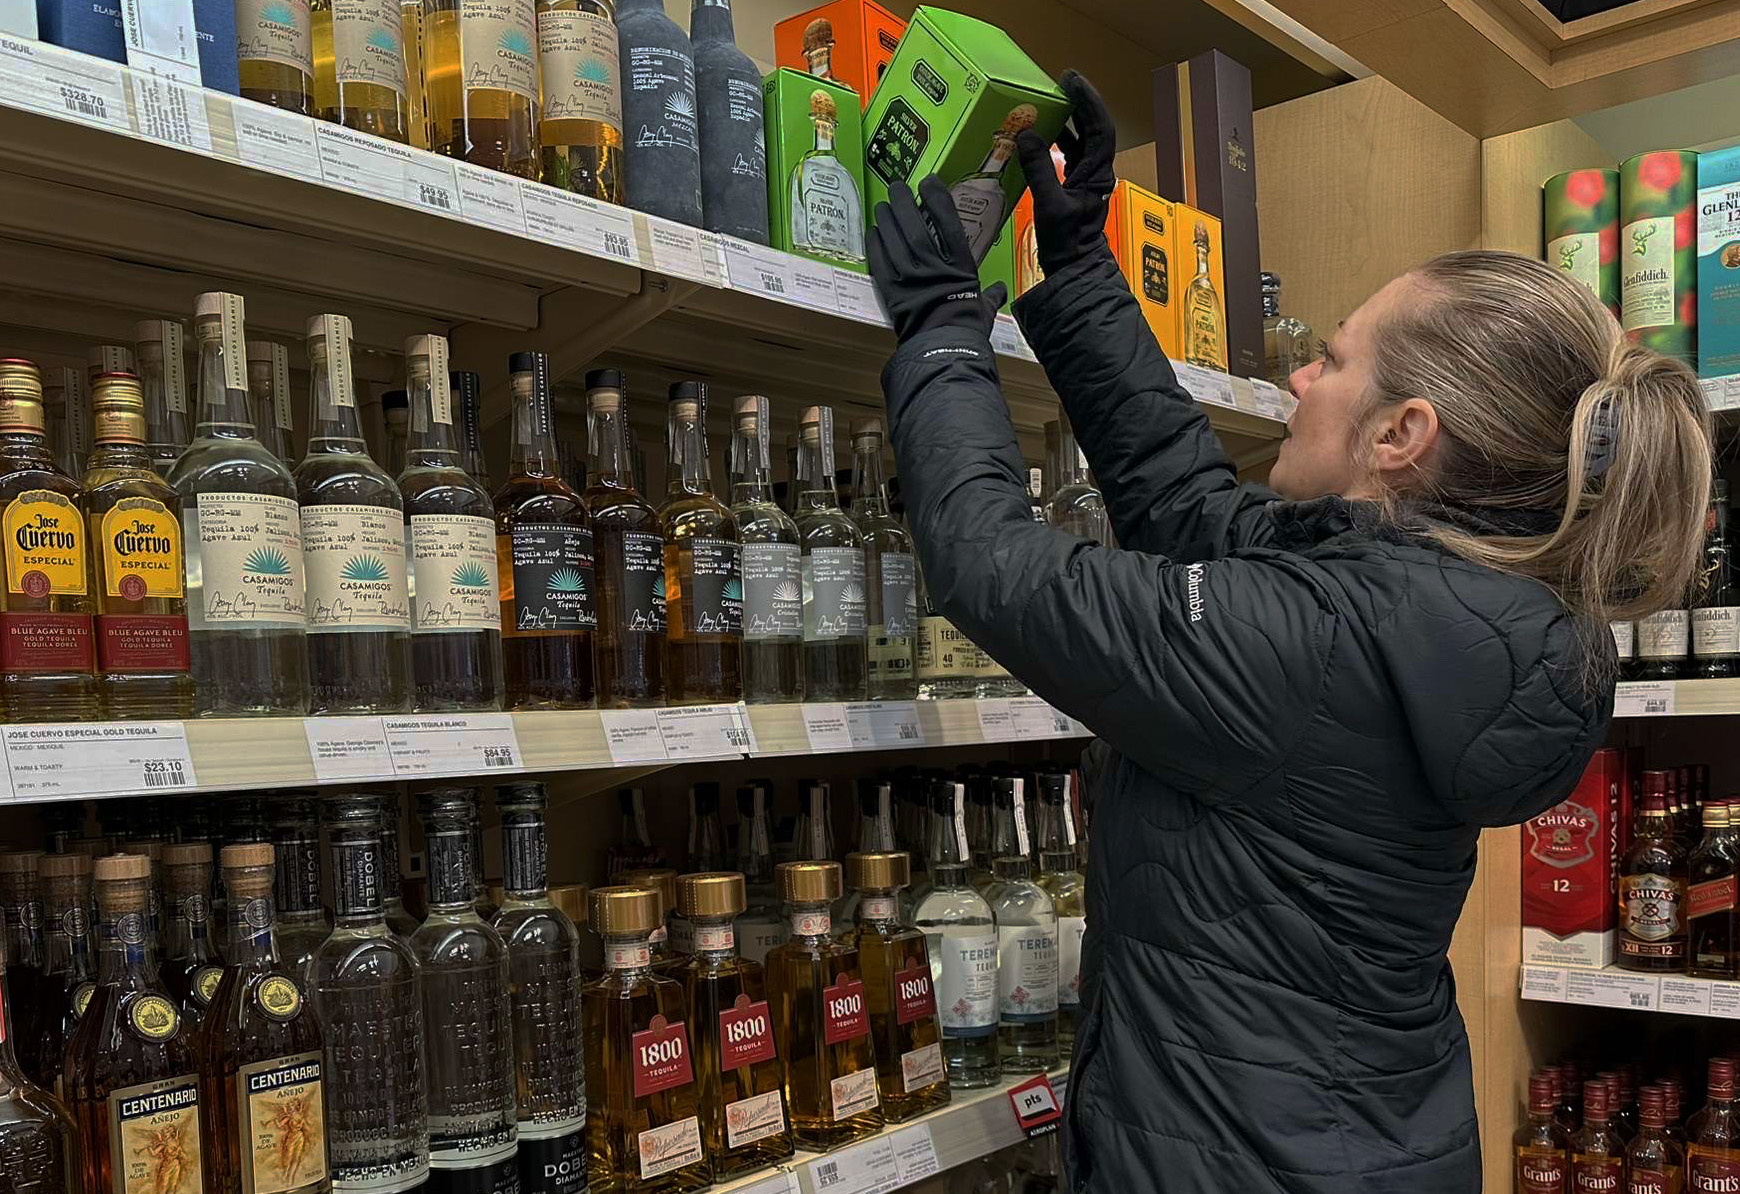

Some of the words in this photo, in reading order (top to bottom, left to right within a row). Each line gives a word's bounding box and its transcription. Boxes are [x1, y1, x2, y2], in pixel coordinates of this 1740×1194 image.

[258, 22, 302, 38] CASAMIGOS
[269, 31, 293, 42] Tequila
[60, 87, 104, 107] $328.70
[584, 89, 608, 102] Tequila
[318, 127, 354, 143] CASAMIGOS
[1228, 156, 1247, 172] 1942
[35, 514, 59, 529] Jose
[132, 519, 155, 534] Jose
[201, 525, 235, 534] Tequila
[240, 523, 260, 534] 100%
[16, 523, 76, 551] Cuervo
[114, 528, 171, 556] Cuervo
[337, 532, 356, 543] 100%
[329, 543, 349, 551] Azul
[441, 550, 458, 558] Azul
[23, 556, 75, 567] ESPECIAL
[121, 560, 170, 570] ESPECIAL
[537, 557, 555, 565] Azul
[242, 575, 295, 587] CASAMIGOS
[339, 582, 392, 592] CASAMIGOS
[256, 586, 286, 597] Tequila
[353, 591, 383, 602] Tequila
[450, 588, 492, 598] CASAMIGOS
[545, 592, 588, 602] CASAMIGOS
[1188, 568, 1205, 622] Columbia
[461, 596, 487, 607] Tequila
[557, 601, 581, 610] Tequila
[11, 627, 35, 635] BLUE
[37, 627, 65, 635] AGAVE
[67, 627, 88, 635] BLEU
[109, 629, 132, 637] BLUE
[133, 629, 161, 637] AGAVE
[162, 629, 183, 637] BLEU
[942, 654, 953, 663] 40
[386, 721, 420, 729] CASAMIGOS
[444, 720, 468, 728] BLANCO
[8, 731, 30, 741] JOSE
[30, 730, 64, 739] CUERVO
[64, 729, 103, 738] ESPECIAL
[103, 728, 125, 736] GOLD
[126, 727, 158, 736] TEQUILA
[484, 748, 511, 758] $84.95
[144, 761, 182, 772] $23.10
[1537, 814, 1587, 828] CHIVAS
[363, 852, 375, 906] DOBEL
[1553, 880, 1570, 893] 12
[1629, 889, 1675, 902] CHIVAS
[1625, 942, 1639, 954] XII
[1661, 945, 1673, 955] 12
[900, 976, 929, 1002] 1800
[829, 994, 862, 1019] 1800
[726, 1015, 767, 1043] 1800
[836, 1017, 858, 1029] TEQUILA
[640, 1036, 683, 1068] 1800
[735, 1040, 763, 1054] TEQUILA
[278, 1056, 301, 1066] GRAN
[250, 1063, 320, 1090] CENTENARIO
[648, 1064, 678, 1079] TEQUILA
[276, 1086, 305, 1099] AÑEJO
[122, 1088, 197, 1116] CENTENARIO
[1024, 1092, 1042, 1109] pts
[150, 1112, 181, 1125] AÑEJO
[1030, 1123, 1057, 1137] AEROPLAN
[1523, 1164, 1561, 1183] Grant's
[1577, 1171, 1616, 1190] Grant's
[1693, 1169, 1740, 1193] Grant's
